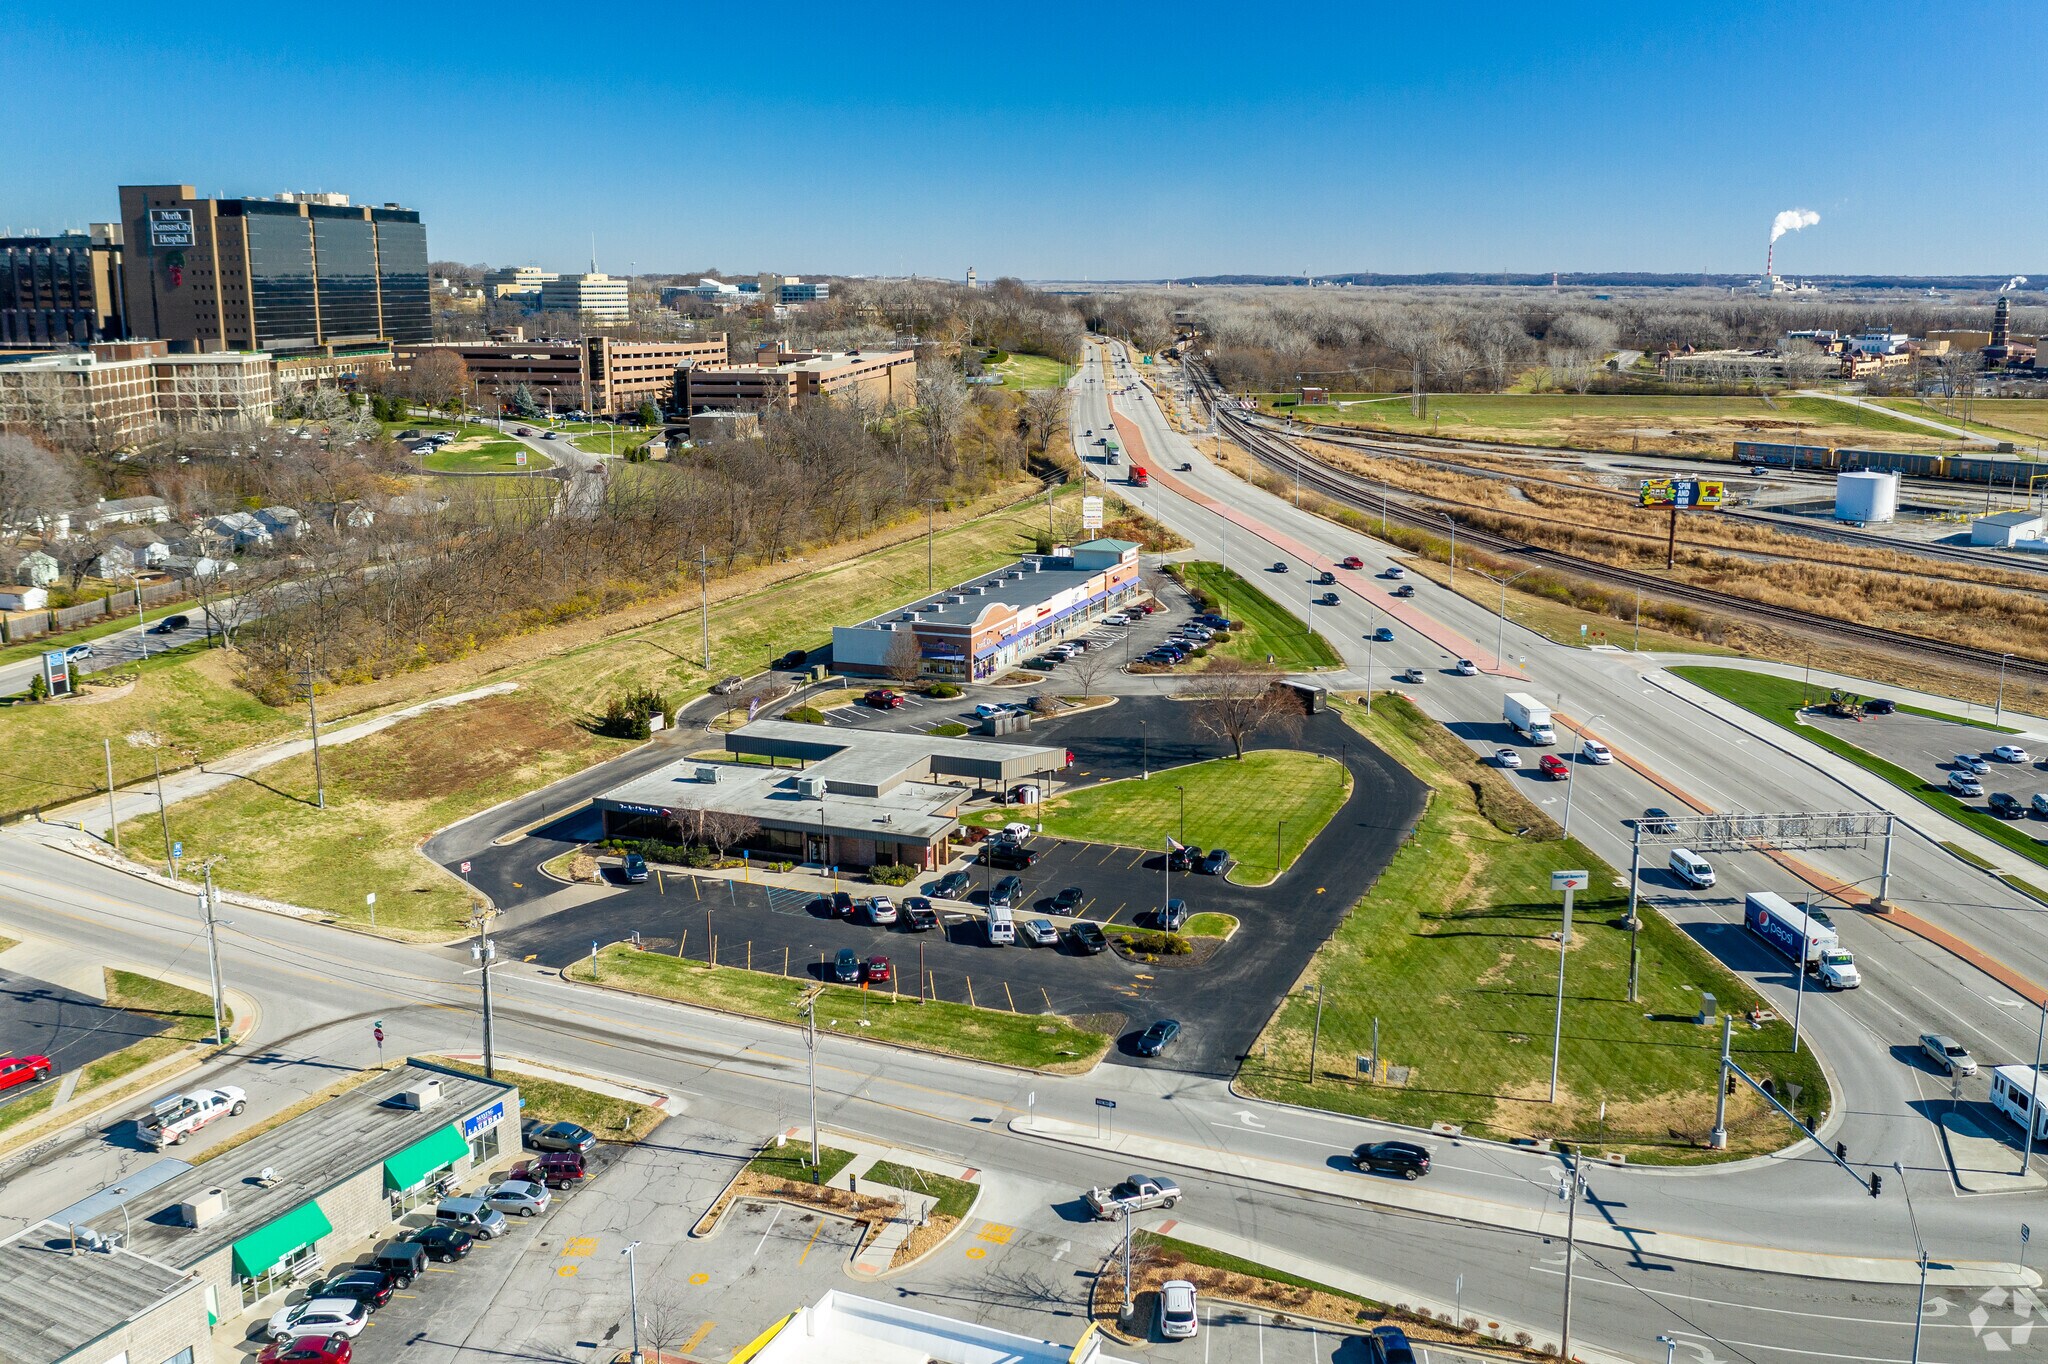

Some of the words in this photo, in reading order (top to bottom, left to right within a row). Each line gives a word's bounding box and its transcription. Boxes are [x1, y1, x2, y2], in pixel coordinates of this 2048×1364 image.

[161, 211, 182, 220] North
[160, 234, 188, 245] Hospital
[1678, 482, 1691, 490] SPIN
[1770, 923, 1793, 945] pepsi
[468, 1111, 502, 1136] LAUNDRY
